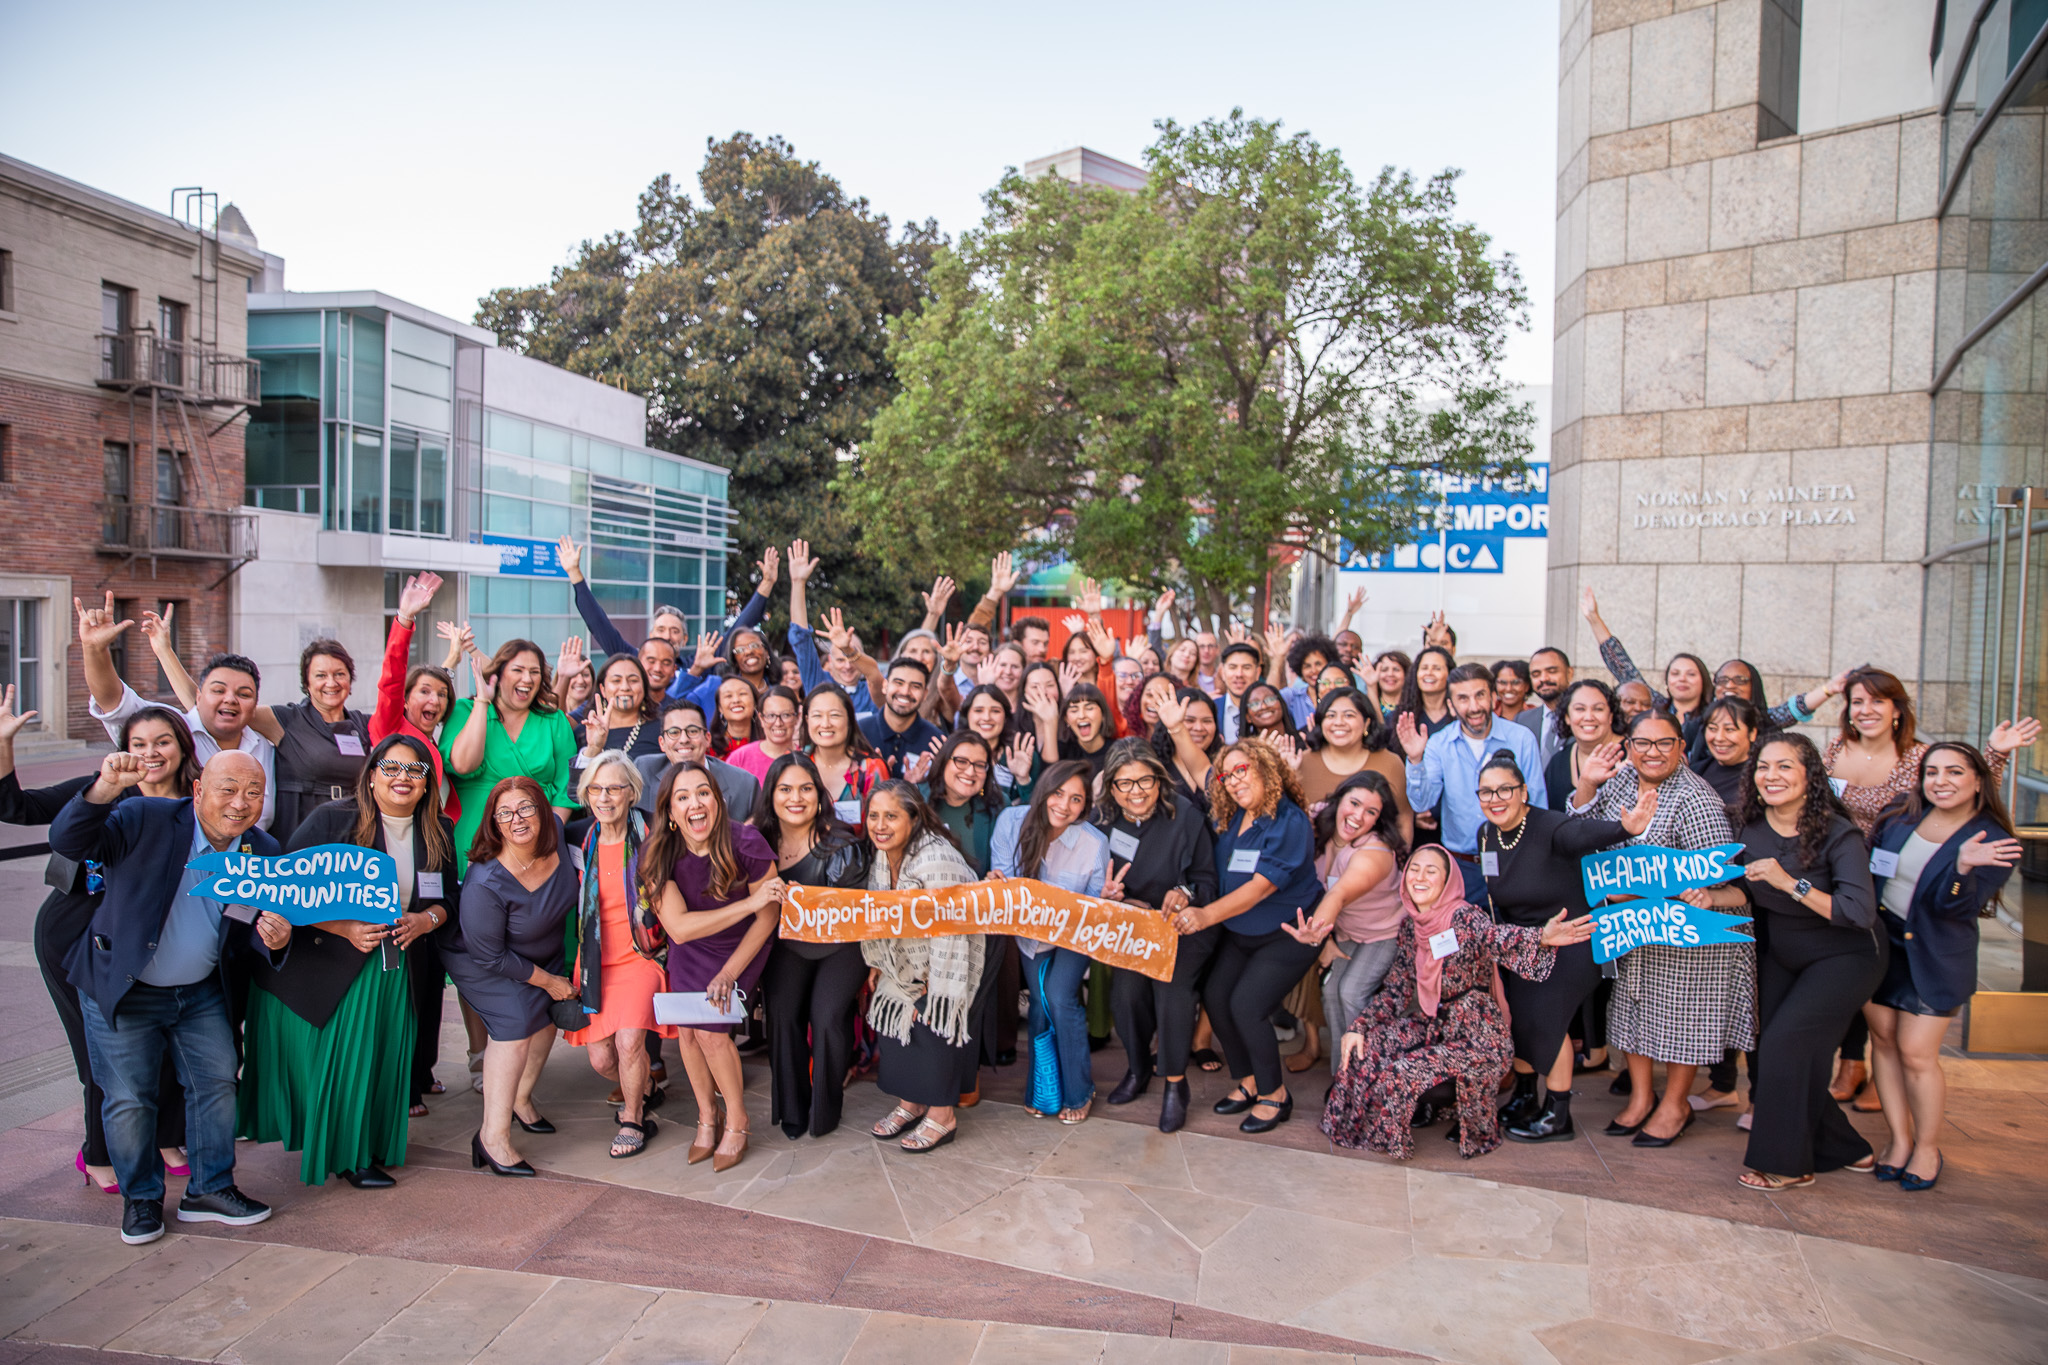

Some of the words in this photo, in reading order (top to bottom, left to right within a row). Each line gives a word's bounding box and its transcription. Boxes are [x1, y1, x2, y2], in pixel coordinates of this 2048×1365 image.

[1636, 488, 1729, 508] NORMAN
[1738, 487, 1756, 504] Y.
[1767, 484, 1857, 503] MINETA
[1633, 509, 1772, 529] DEMOCRACY
[1781, 507, 1857, 526] PLAZA
[225, 851, 381, 880] WELCOMING
[1586, 853, 1668, 890] HEALTHY
[1673, 850, 1727, 882] KIDS
[213, 877, 398, 912] COMMUNITIES!
[785, 886, 903, 936] Supporting
[910, 895, 967, 930] Child
[970, 886, 1071, 942] Well-Being
[1069, 899, 1161, 960] Together
[1599, 901, 1687, 934] STRONG
[1599, 923, 1700, 958] FAMILIES
